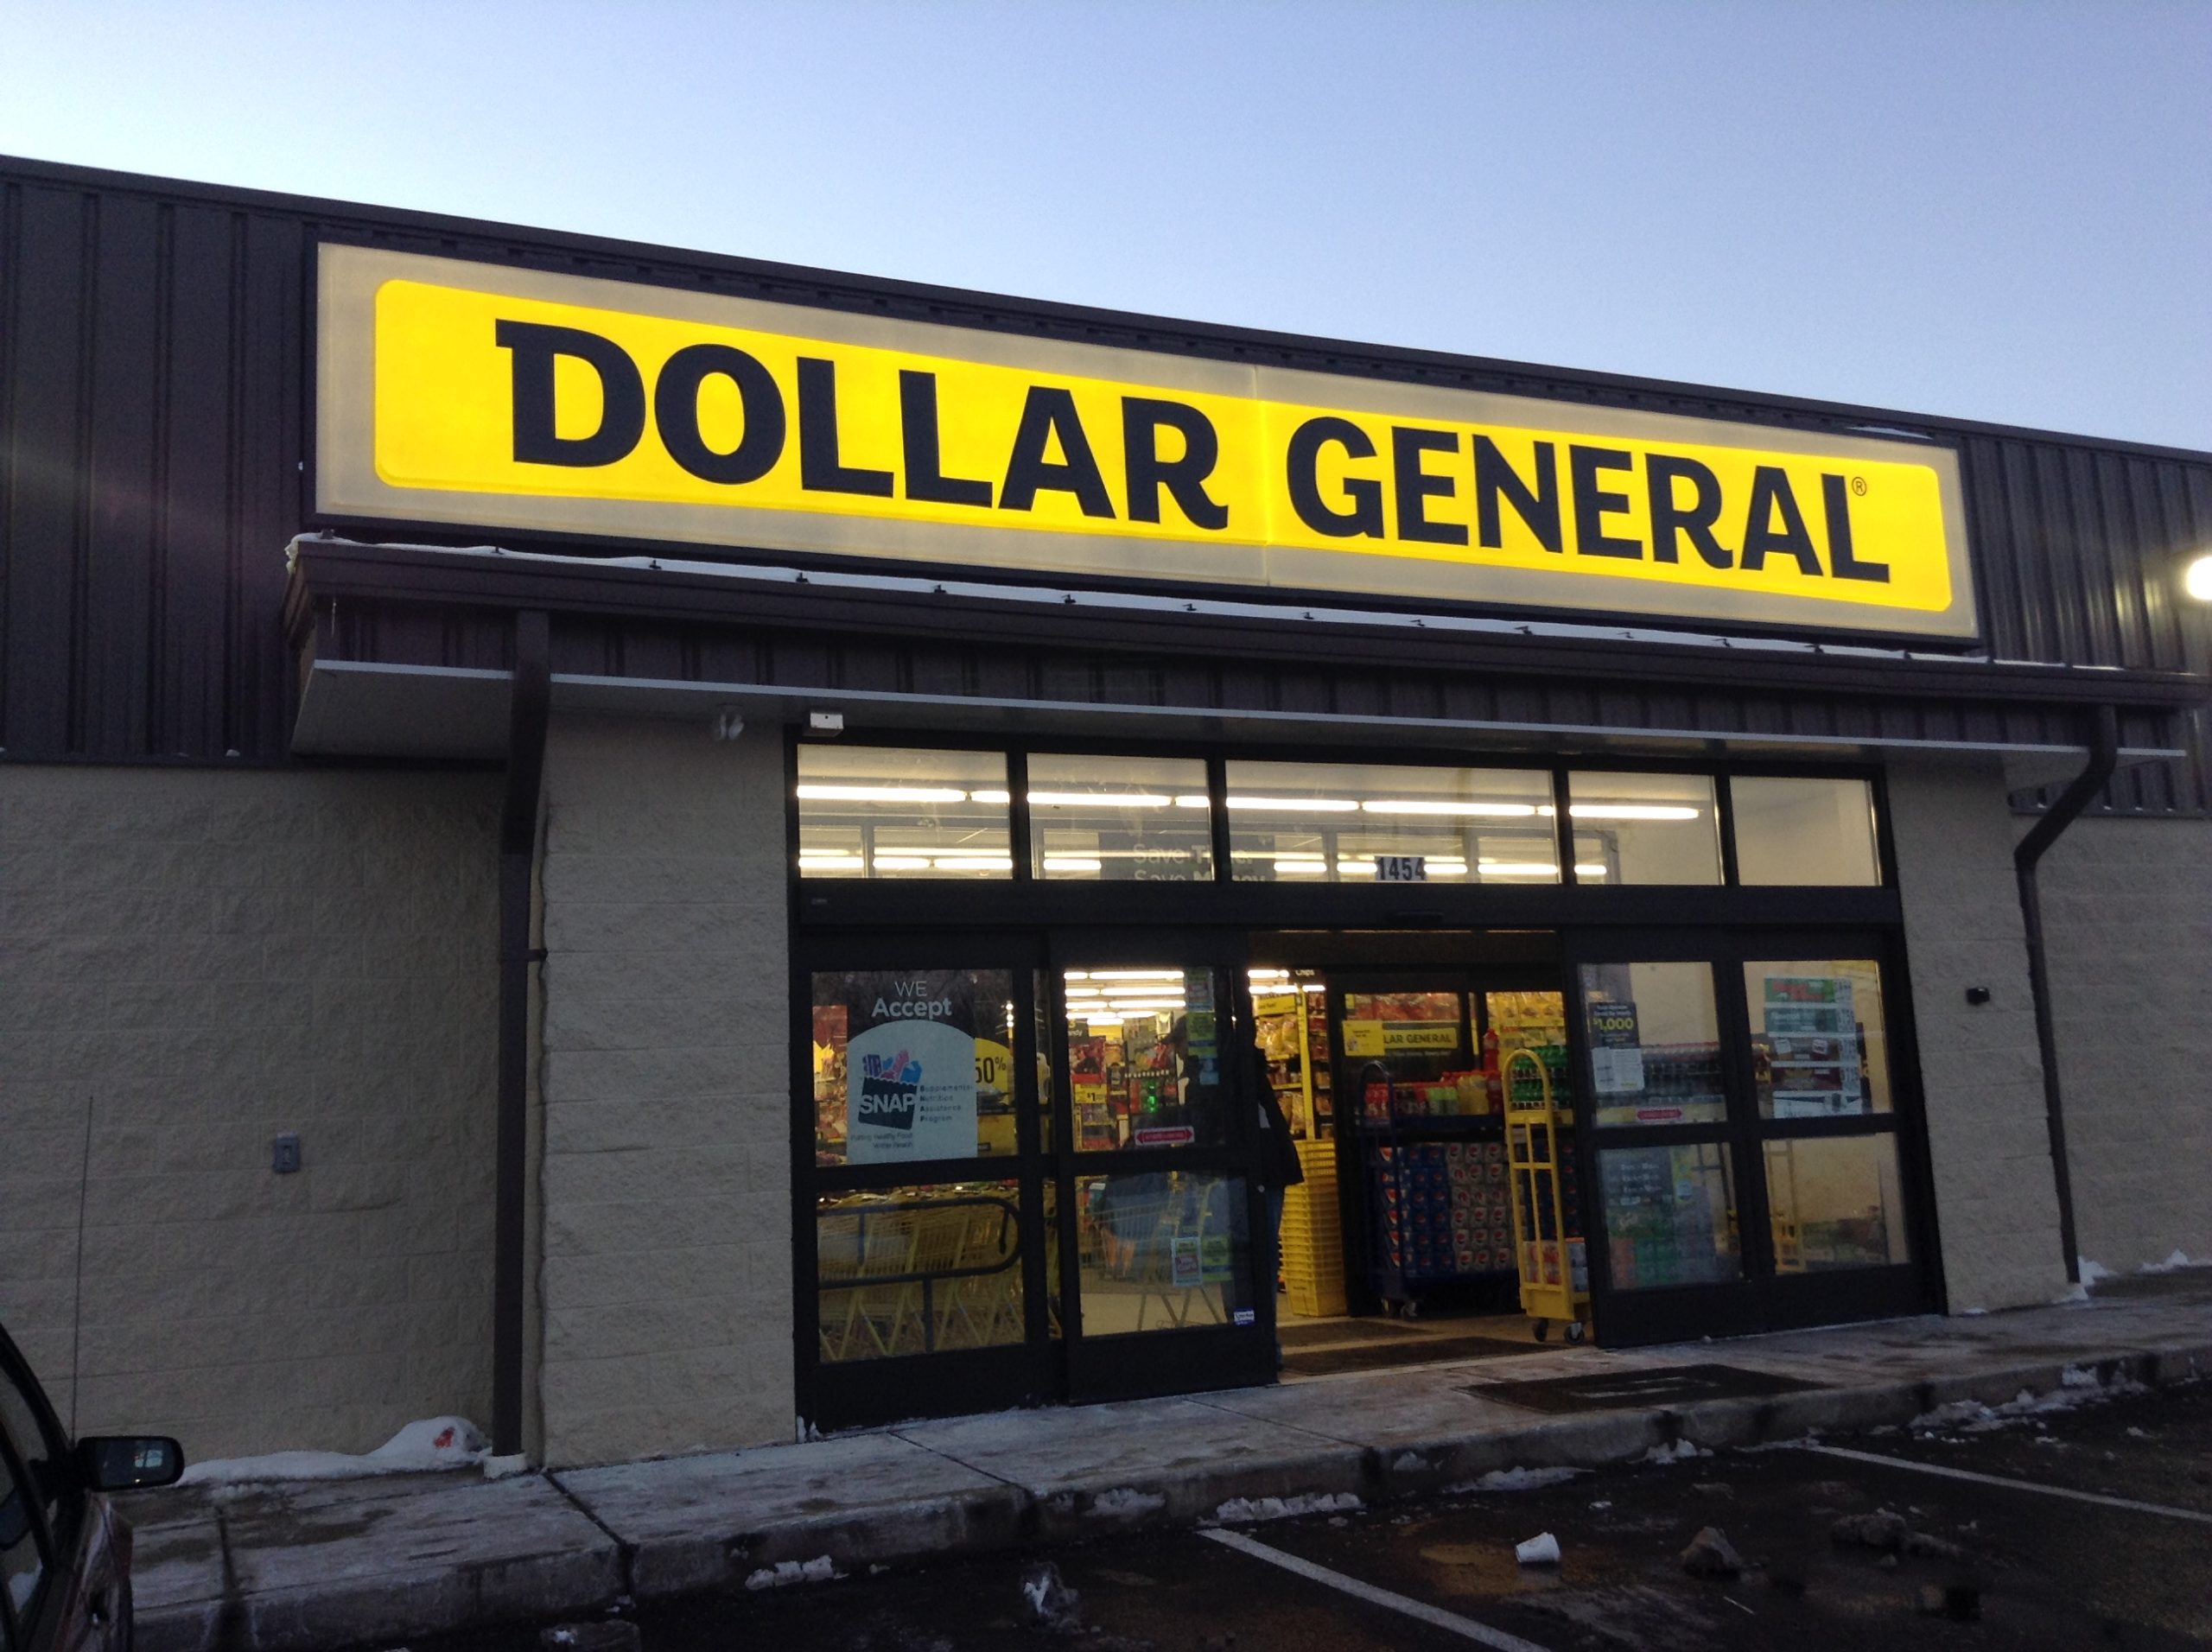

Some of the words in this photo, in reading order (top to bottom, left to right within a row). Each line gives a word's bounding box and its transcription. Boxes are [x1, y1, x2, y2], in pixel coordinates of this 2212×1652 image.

[494, 318, 1229, 531] DOLLAR
[1286, 416, 1891, 584] GENERAL
[1133, 842, 1185, 864] Save
[1376, 856, 1425, 880] 1454
[894, 981, 927, 997] WE
[871, 997, 952, 1020] Accept
[1592, 1017, 1634, 1032] $1,000
[1383, 1034, 1404, 1045] LAR
[1406, 1033, 1452, 1044] GENERAL
[859, 1093, 917, 1115] SNAP
